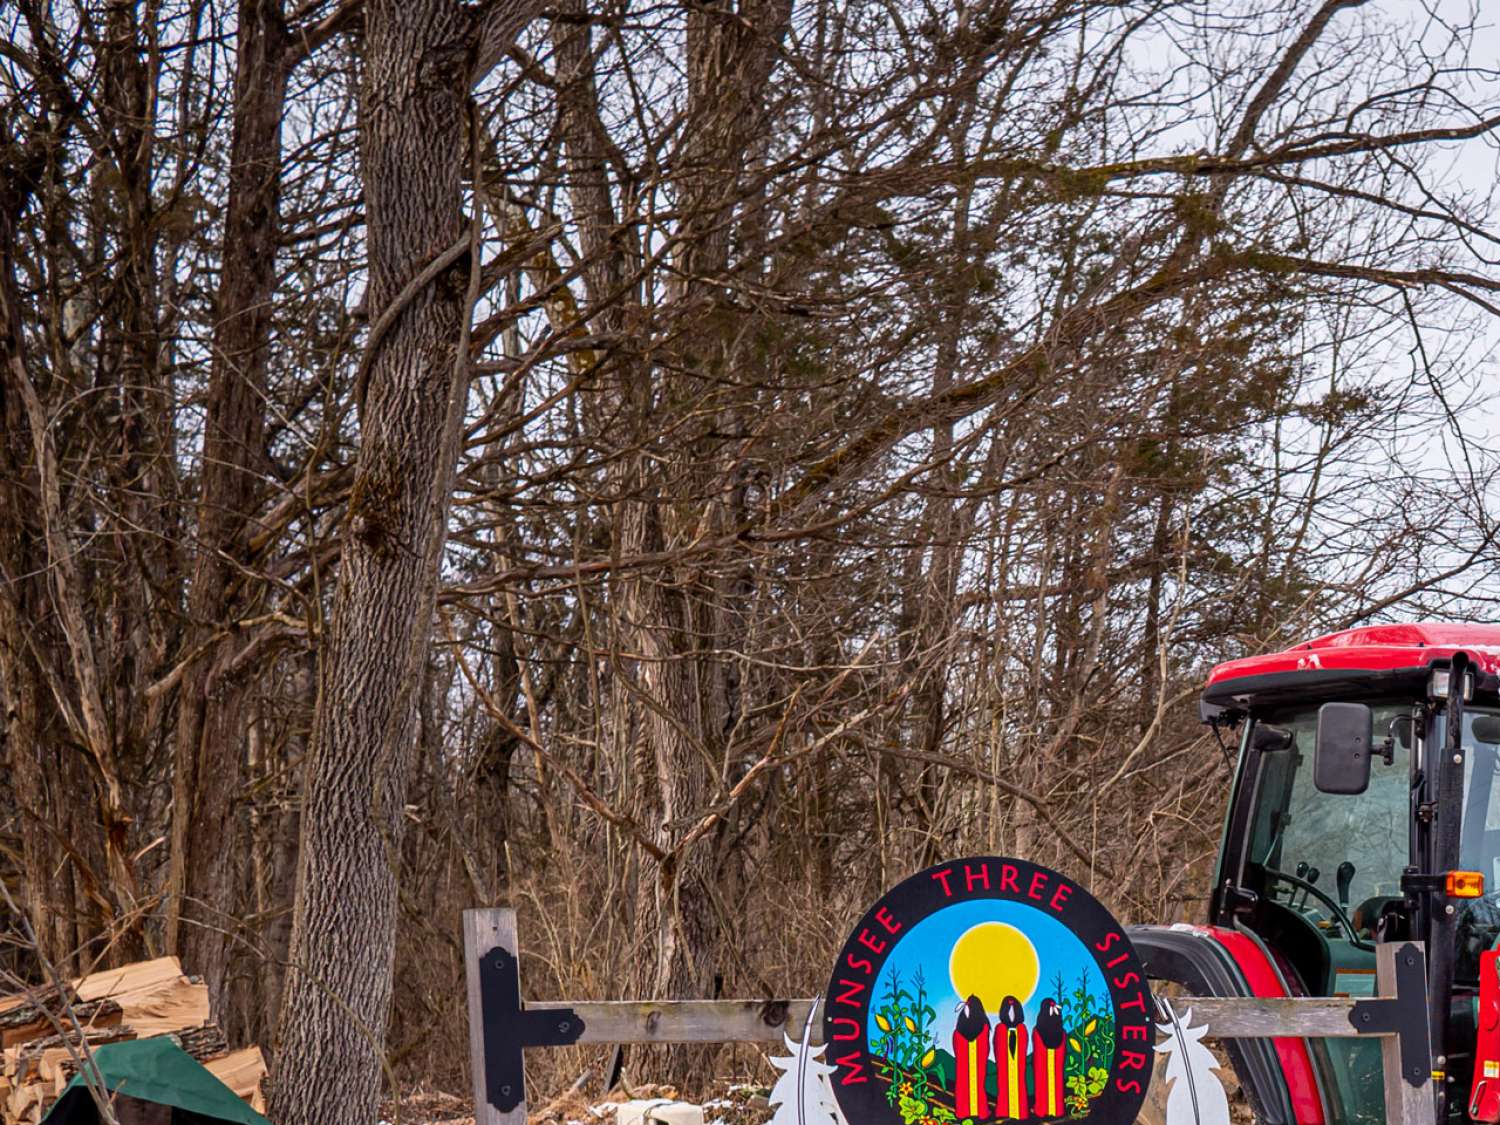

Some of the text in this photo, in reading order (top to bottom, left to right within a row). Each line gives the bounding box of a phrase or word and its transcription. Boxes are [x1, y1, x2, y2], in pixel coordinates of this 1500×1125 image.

[832, 863, 1148, 1095] MUNSEE THREE SISTERS
